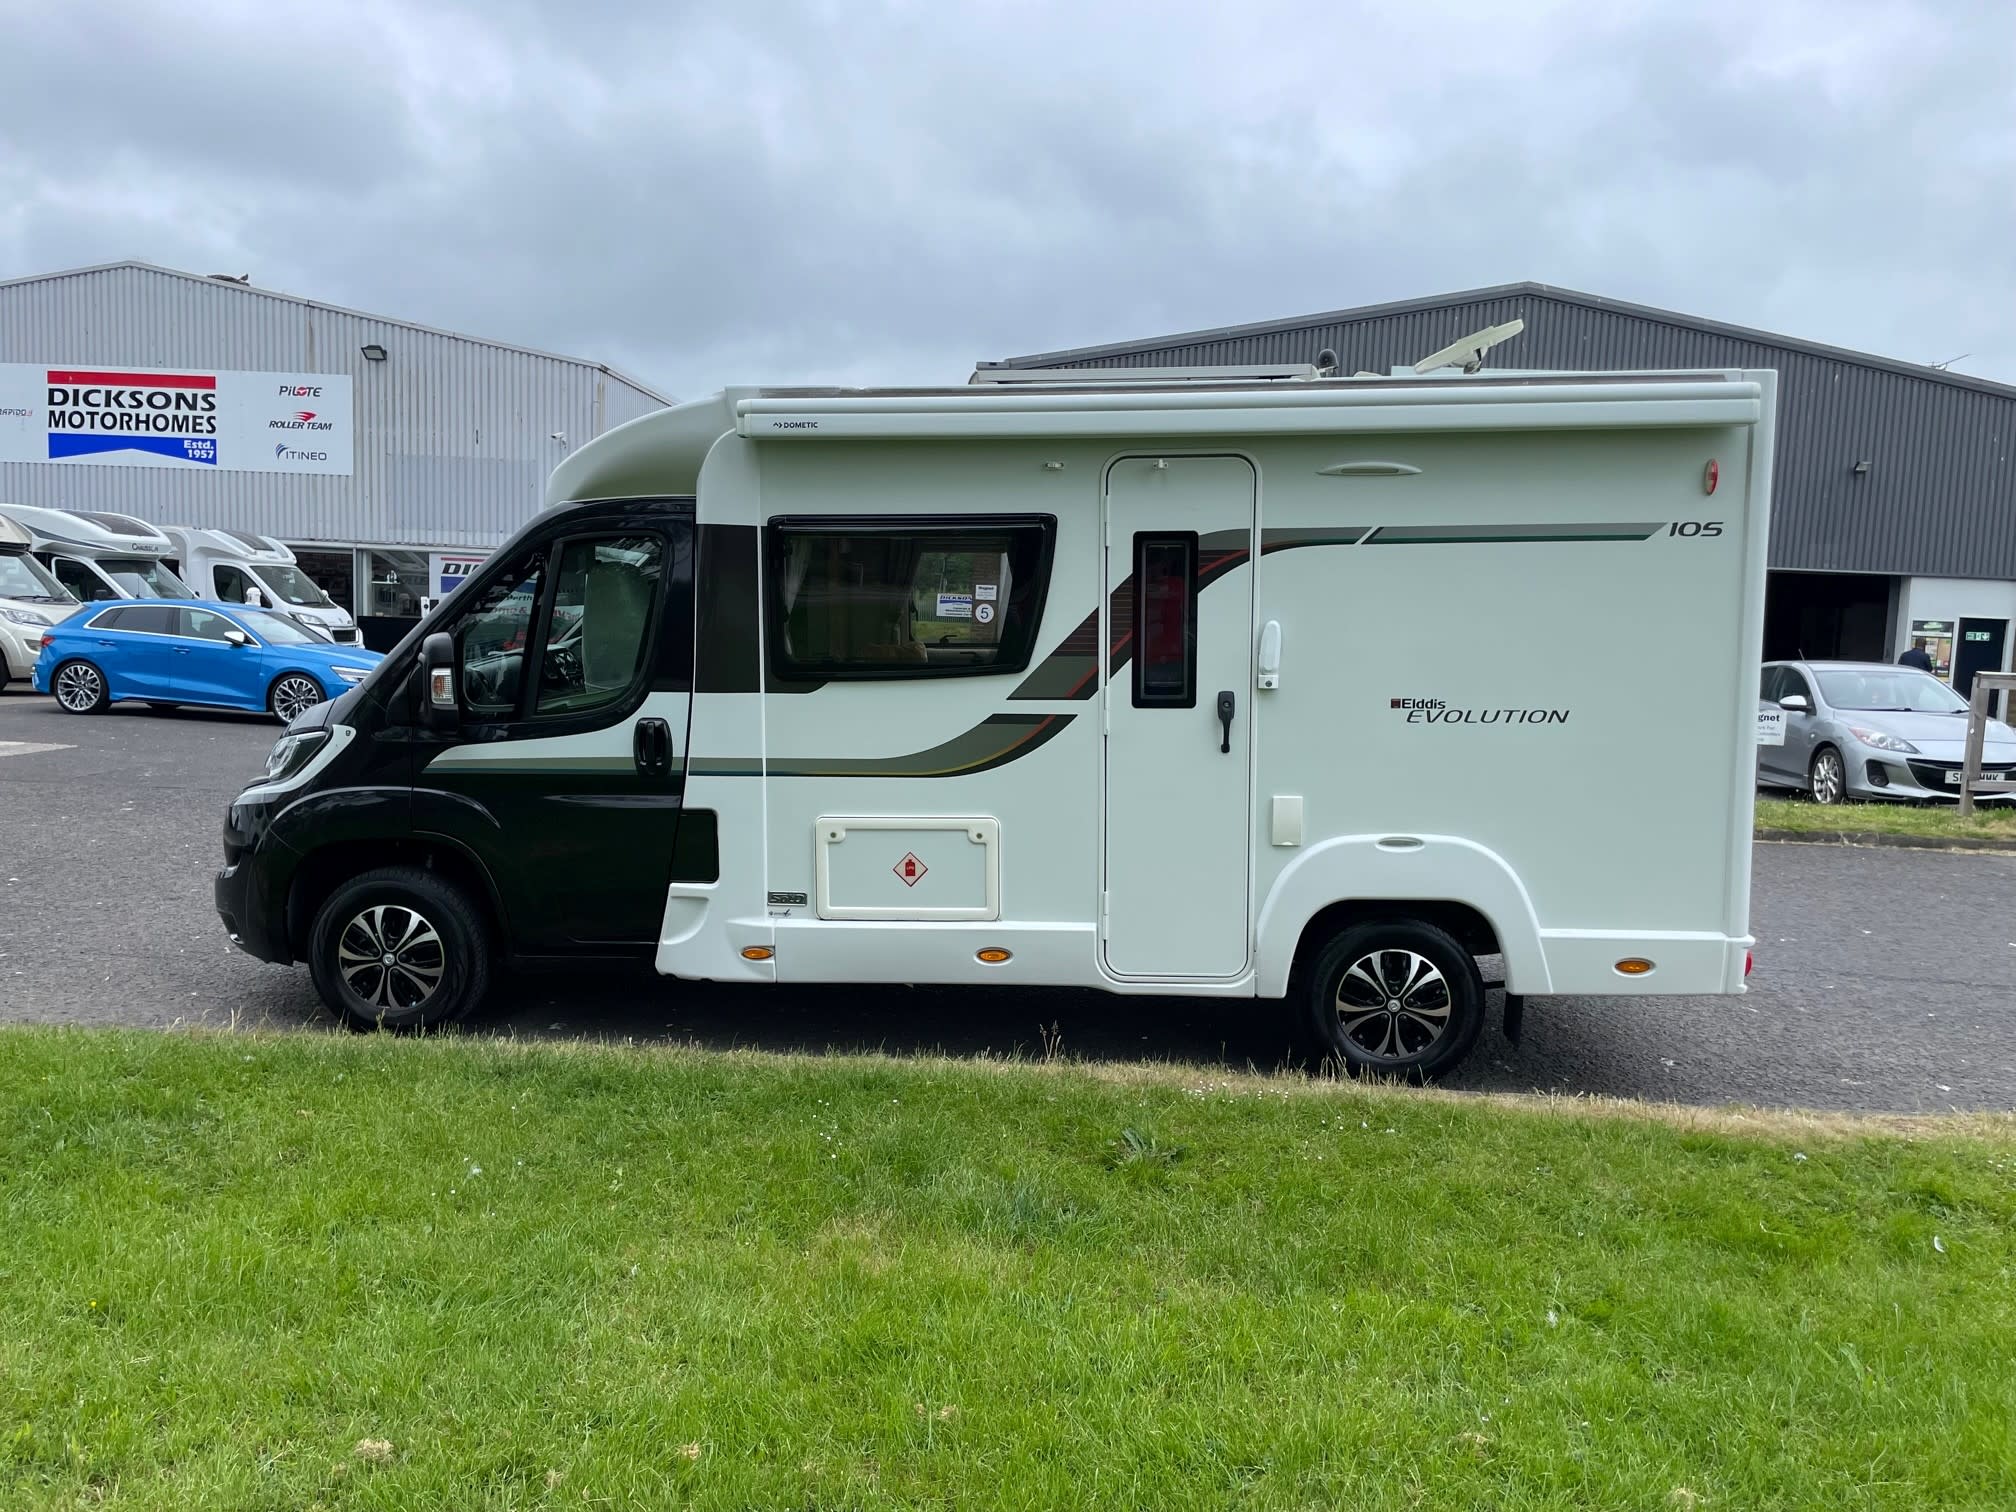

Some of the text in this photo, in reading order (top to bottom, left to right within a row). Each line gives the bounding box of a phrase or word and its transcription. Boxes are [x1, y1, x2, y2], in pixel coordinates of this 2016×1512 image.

[47, 387, 217, 412] DICKSONS
[47, 409, 217, 434] MOTORHOMES
[269, 420, 333, 431] ROLLER TEAM
[783, 421, 819, 429] DOMETIC
[183, 439, 214, 450] Estd.
[187, 449, 215, 459] 1957
[285, 450, 327, 461] ITINEO
[980, 607, 989, 619] 5
[1401, 698, 1446, 710] Elddis
[1406, 709, 1570, 724] EVOLUTION
